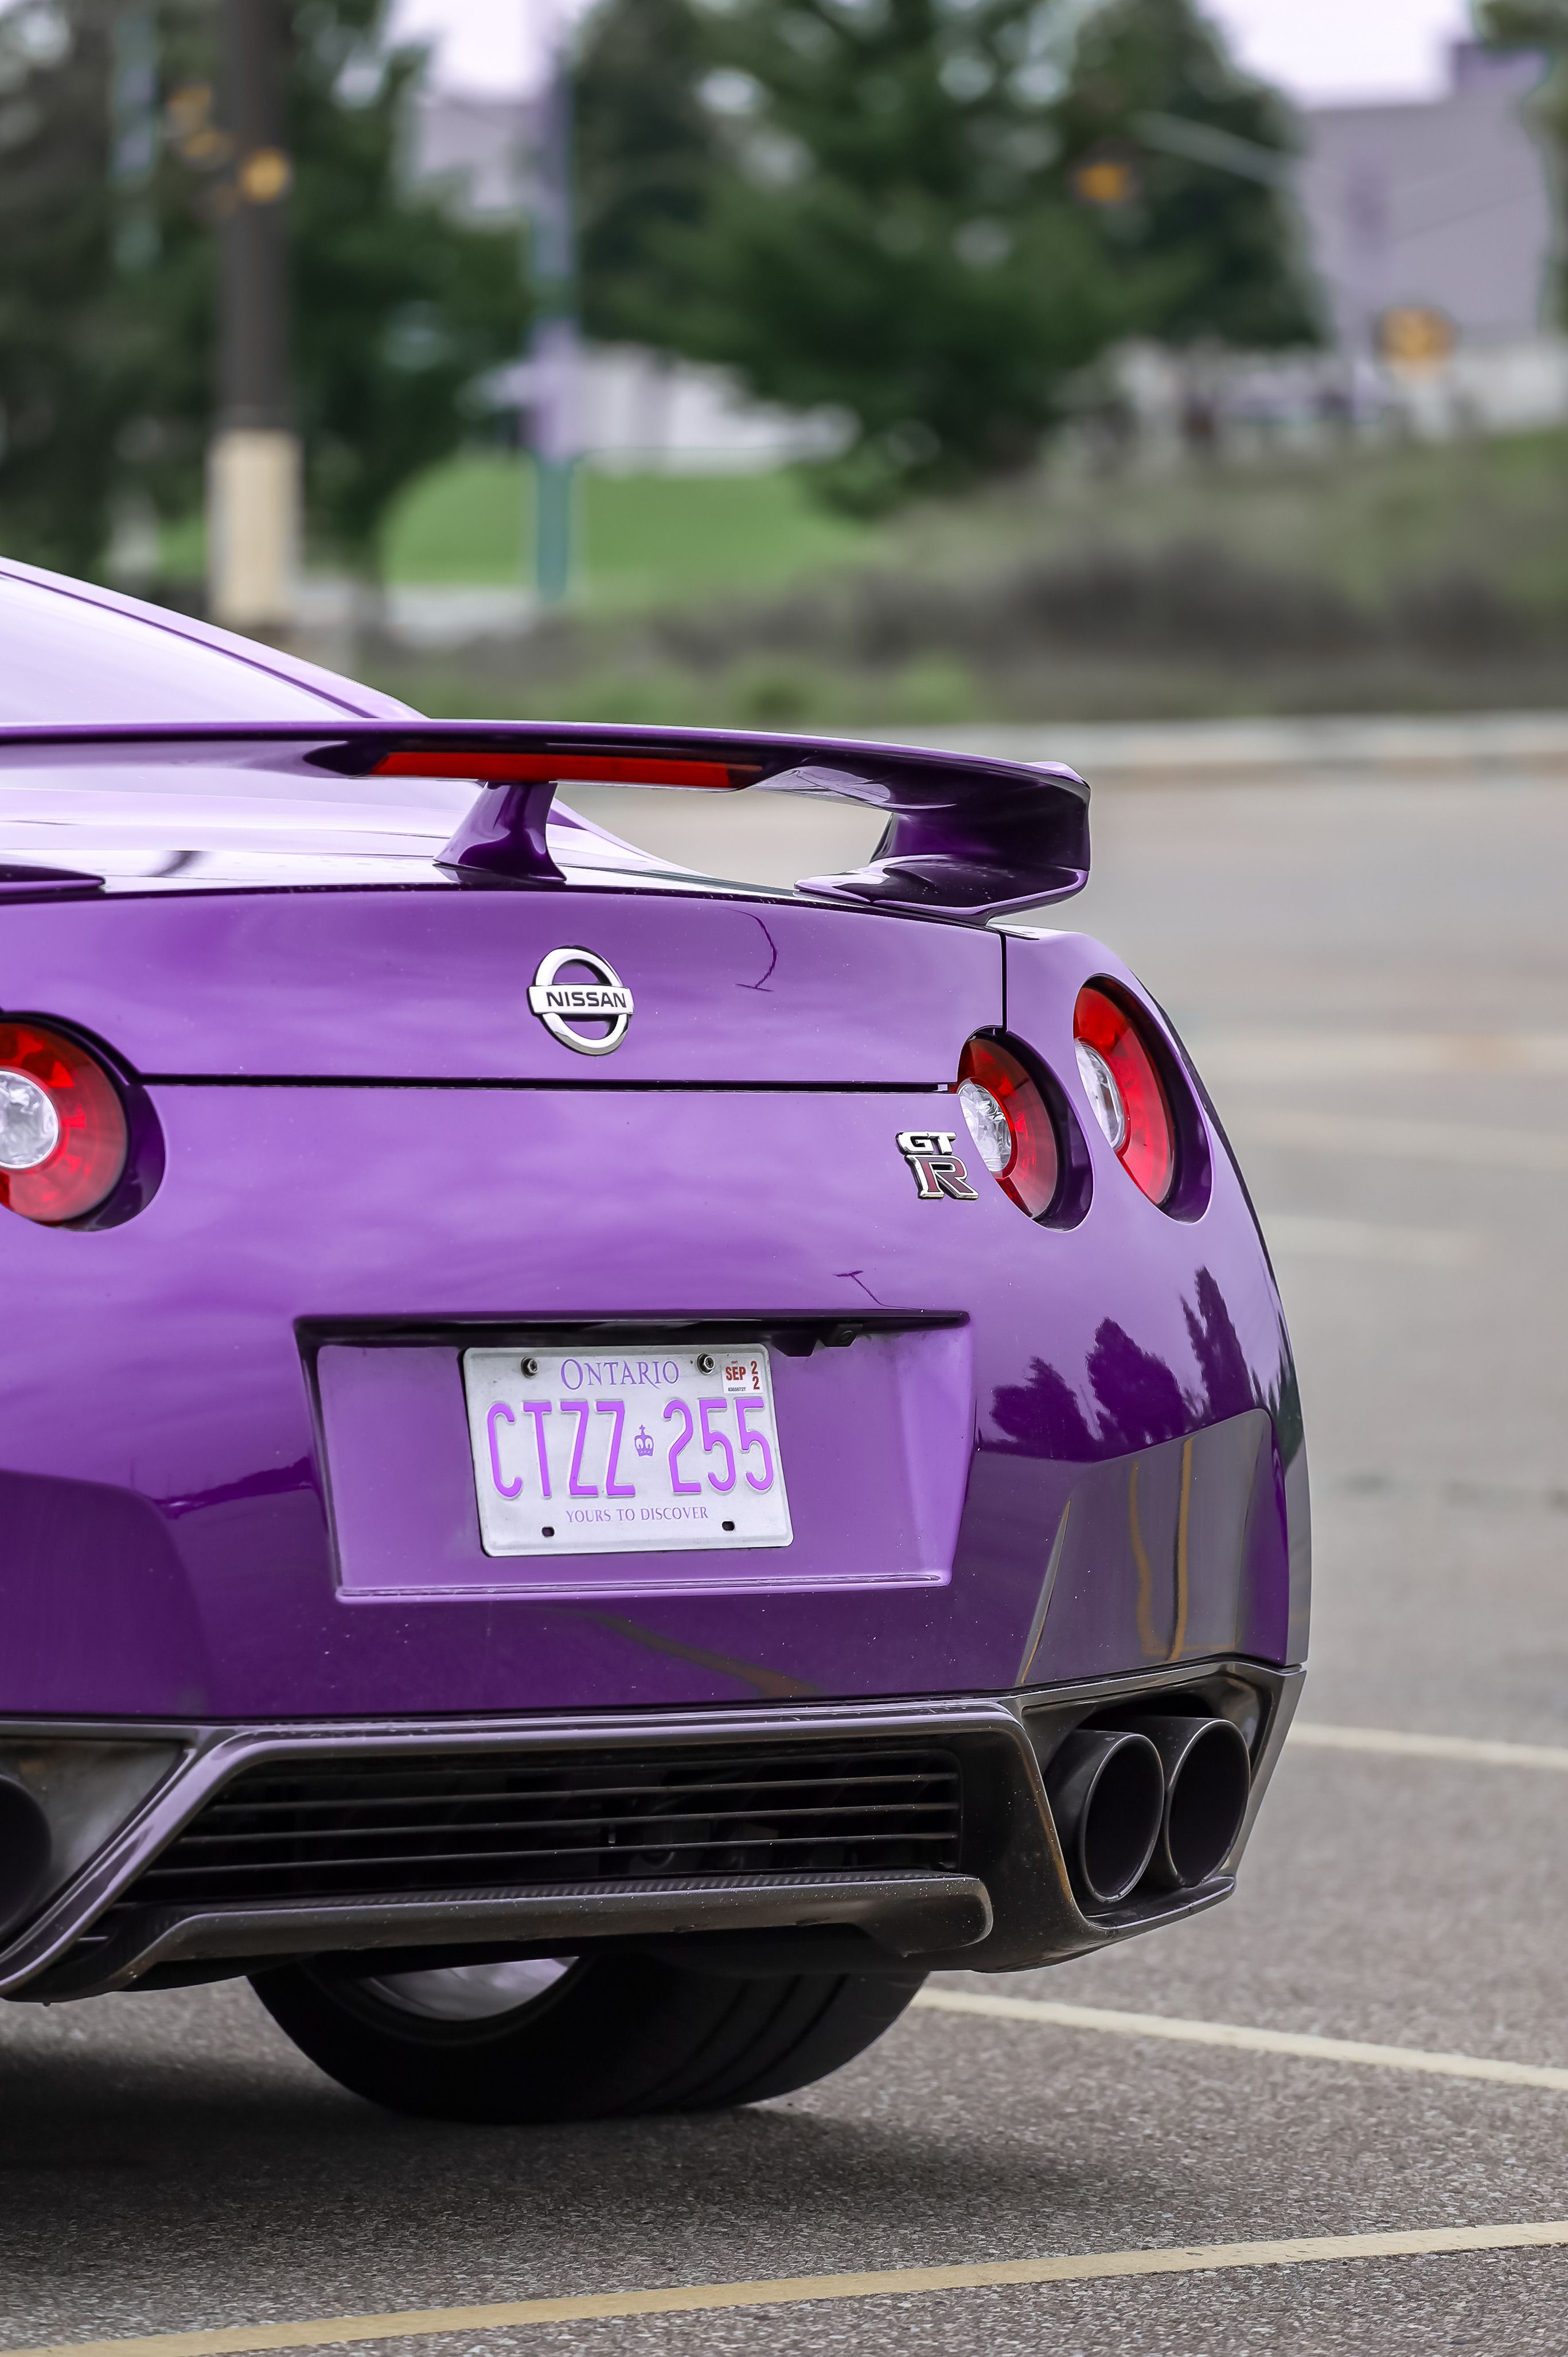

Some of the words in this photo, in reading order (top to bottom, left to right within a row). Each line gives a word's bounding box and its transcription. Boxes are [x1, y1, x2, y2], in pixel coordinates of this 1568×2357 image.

[546, 992, 626, 1008] NISSAN
[895, 1132, 957, 1155] GT
[904, 1154, 979, 1200] R
[560, 1358, 679, 1390] ONTARIO
[726, 1366, 746, 1381] SEP
[487, 1400, 635, 1497] CTZZ
[664, 1397, 774, 1492] 255
[565, 1509, 610, 1523] YOURS
[615, 1509, 635, 1521] TO
[640, 1506, 709, 1521] DISCOVER
